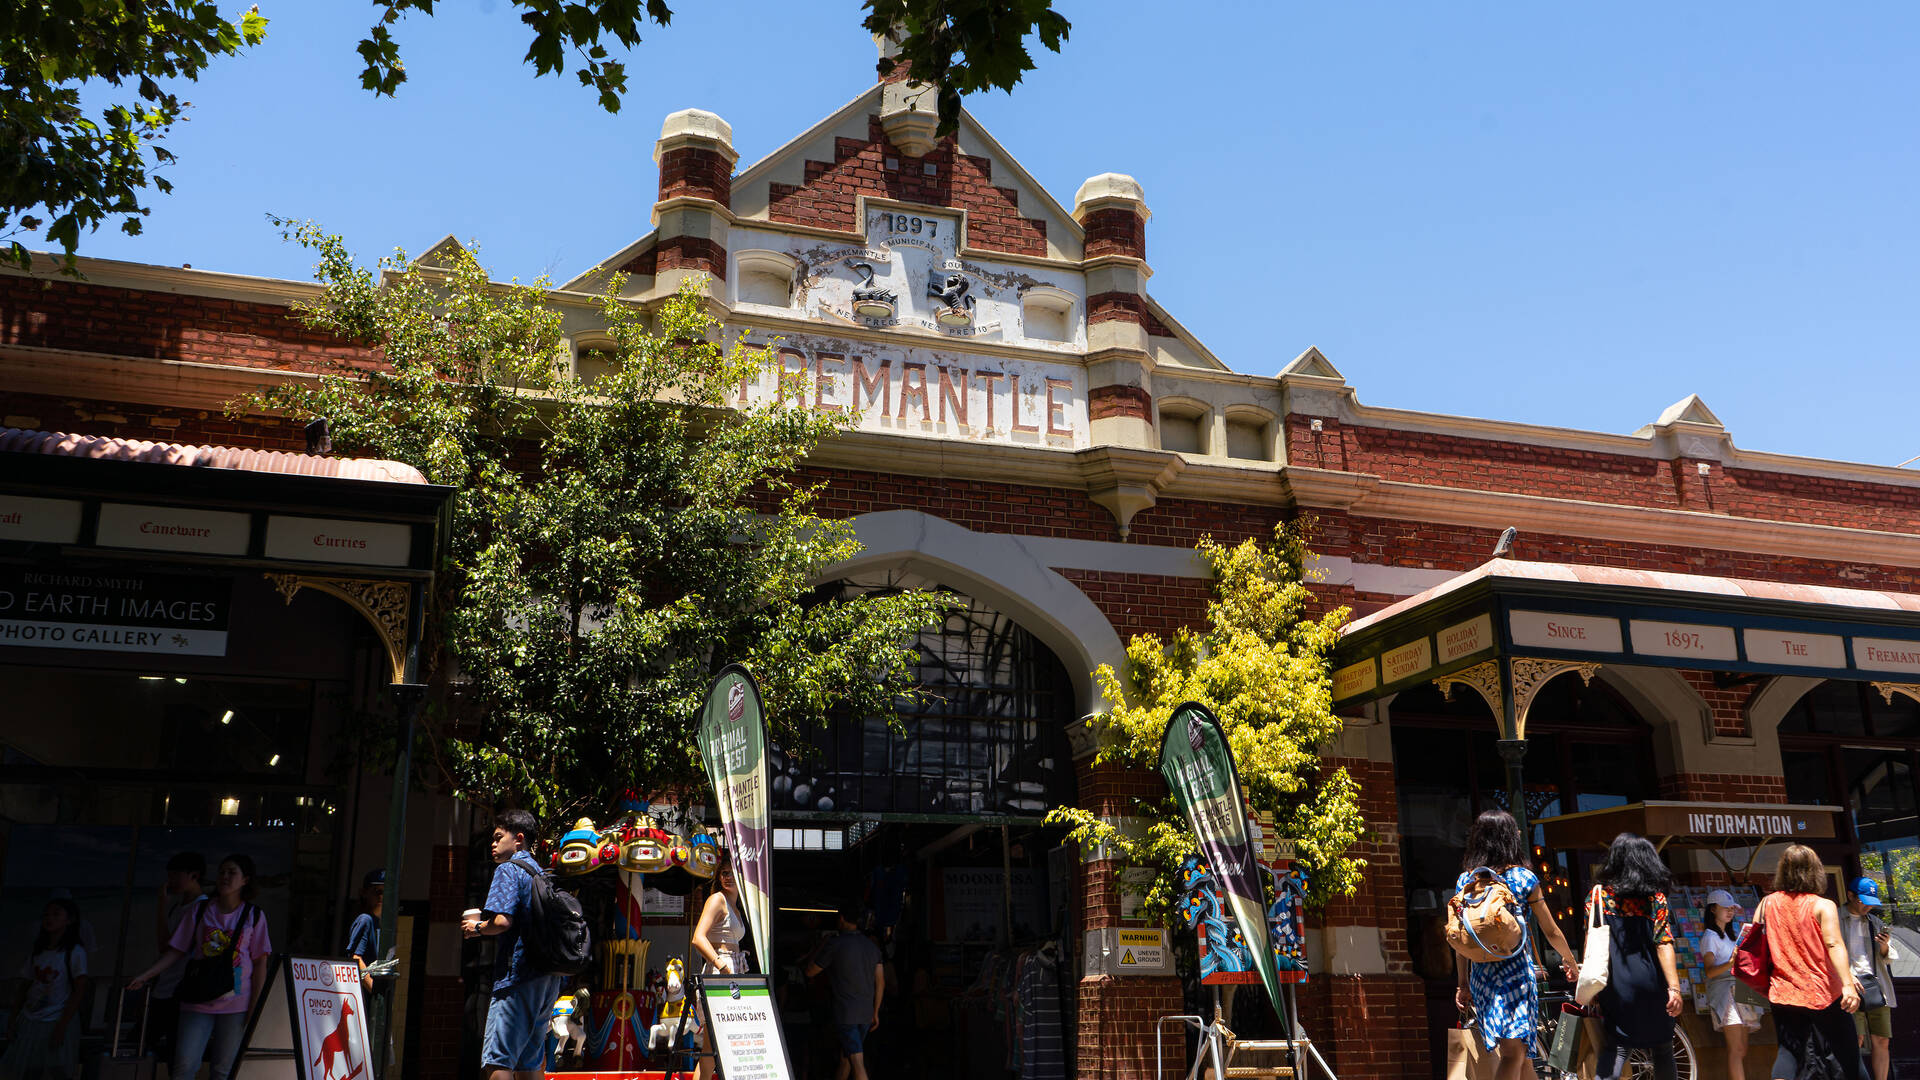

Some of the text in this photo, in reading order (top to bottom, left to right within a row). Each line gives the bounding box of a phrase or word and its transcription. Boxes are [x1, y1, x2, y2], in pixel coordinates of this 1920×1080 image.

[883, 213, 938, 238] 1897
[836, 246, 887, 260] FREMANTLE
[887, 237, 937, 253] MUNICIPAL
[836, 308, 857, 322] NEC
[920, 320, 941, 332] NEC
[948, 325, 988, 336] PRETIO
[738, 342, 1073, 437] FREMANTLE
[0, 511, 24, 526] aft
[139, 521, 211, 538] Caneware
[313, 534, 367, 549] Curries
[24, 572, 144, 591] RICHARD SMYTH
[25, 592, 109, 616] EARTH
[121, 598, 216, 622] IMAGES
[72, 628, 162, 646] GALLERY
[1446, 624, 1479, 644] HOLIDAY
[1386, 643, 1424, 667] SATURDAY
[1447, 636, 1480, 657] MONDAY
[1392, 660, 1420, 677] SUNDAY
[1688, 813, 1793, 835] INFORMATION
[1121, 934, 1159, 942] WARNING
[293, 962, 359, 984] SOLD HERE
[309, 998, 333, 1008] DINGO
[716, 1011, 767, 1022] TRADING DAYS
